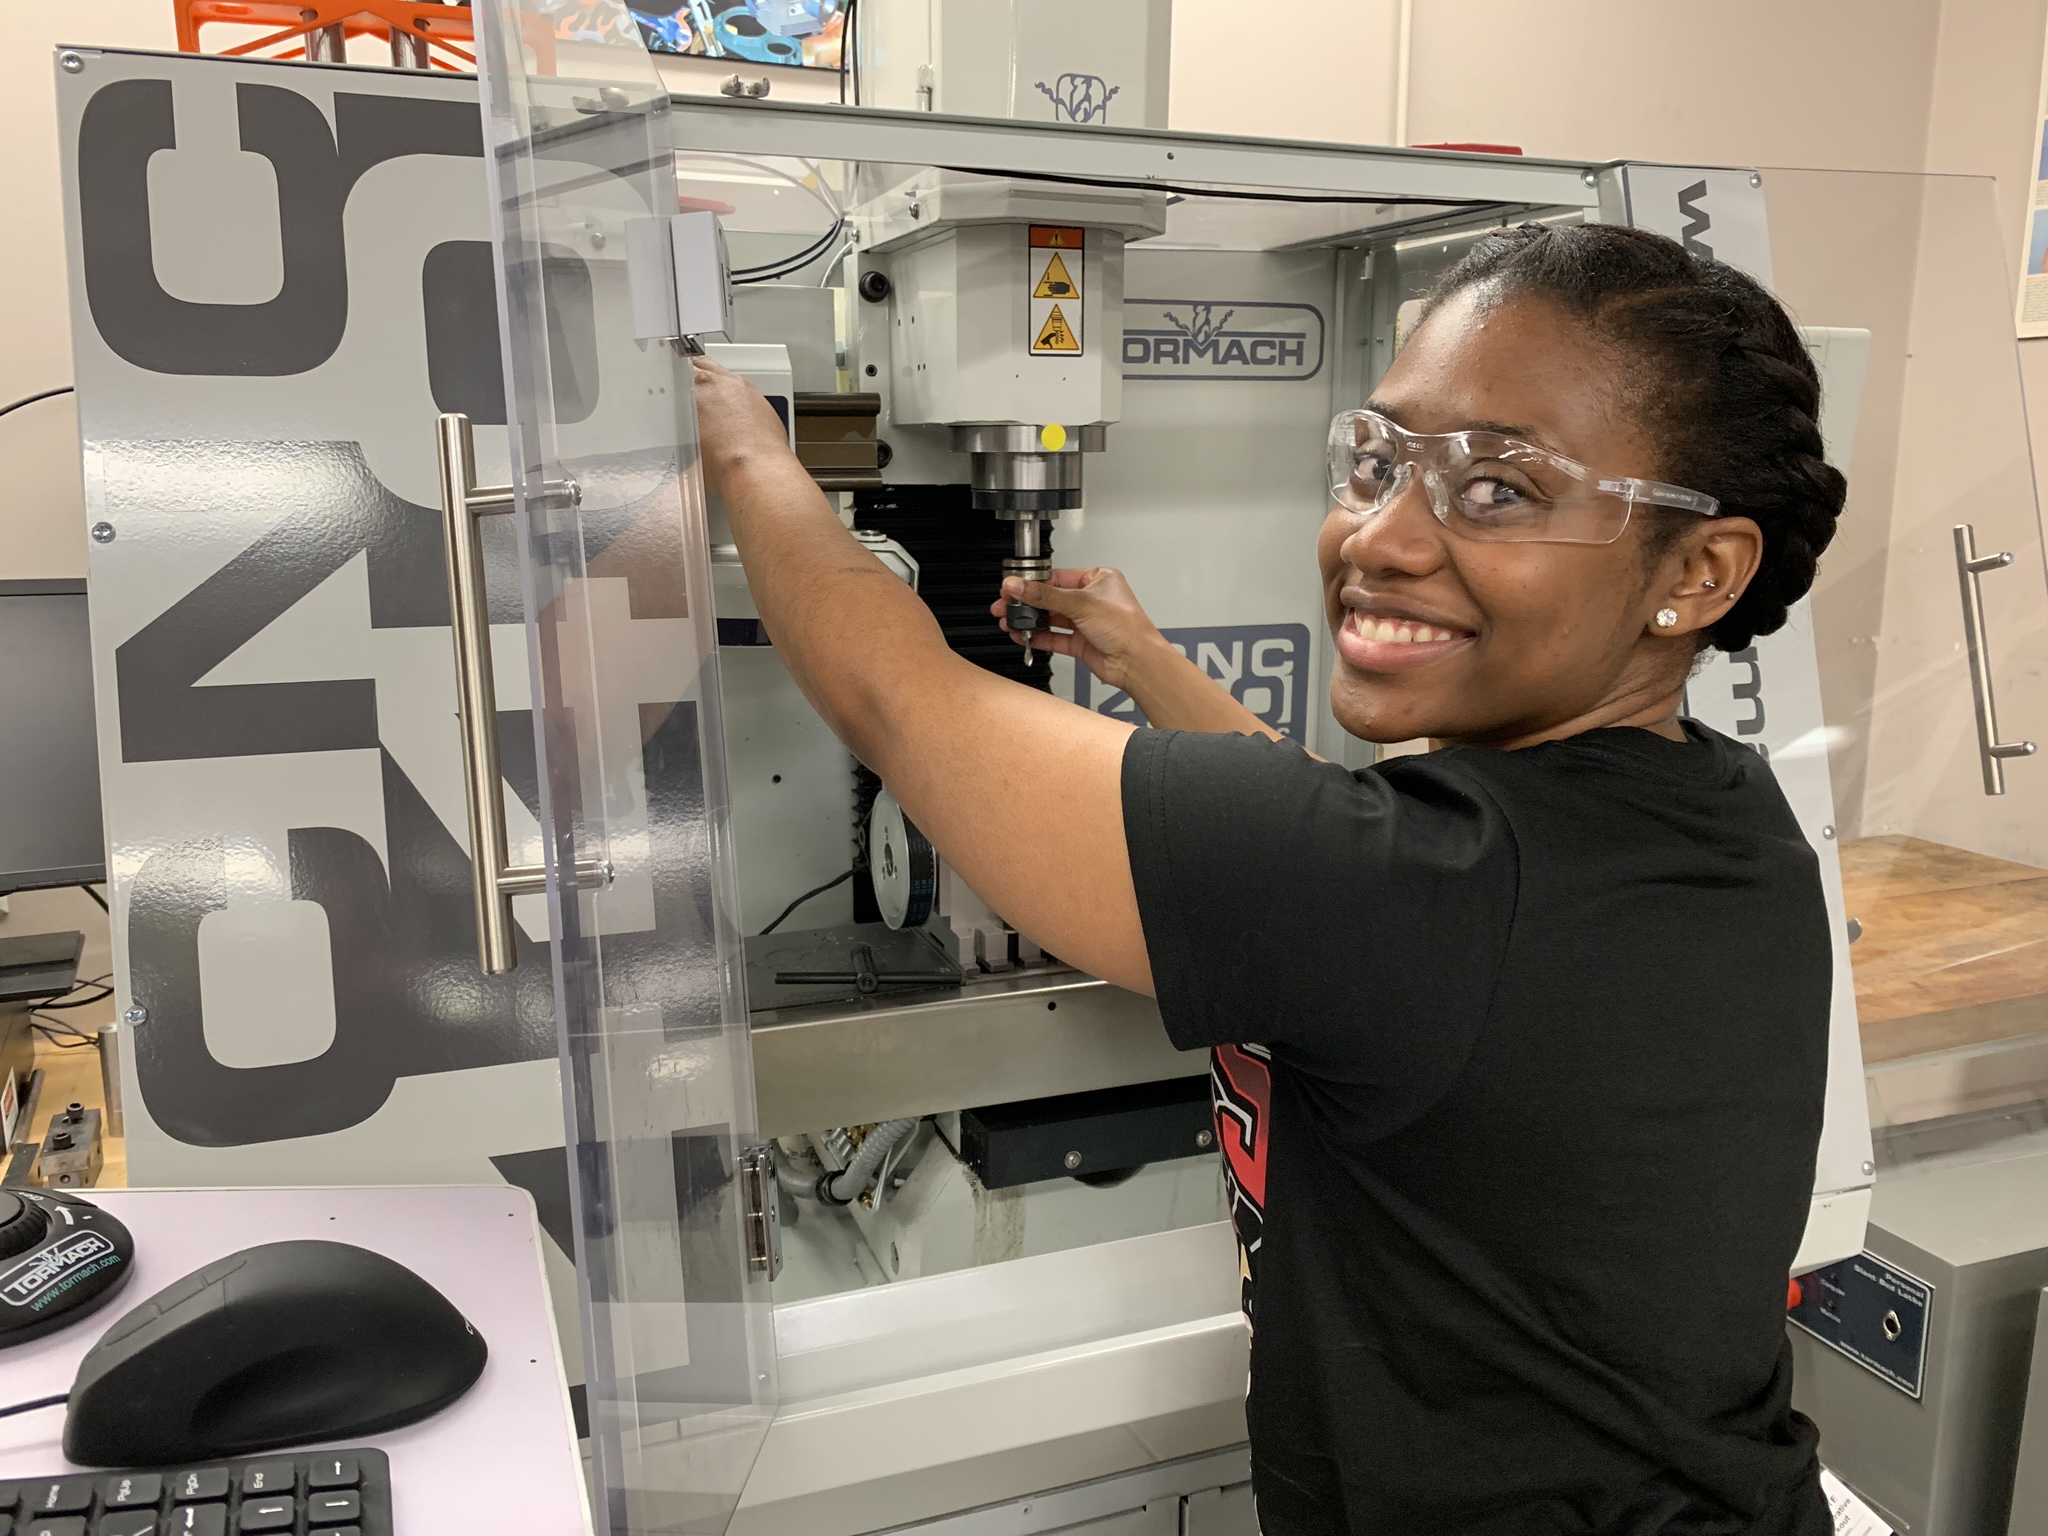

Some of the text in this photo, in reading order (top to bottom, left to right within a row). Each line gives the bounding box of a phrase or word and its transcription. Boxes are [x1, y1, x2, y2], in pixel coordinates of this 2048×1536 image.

[1122, 334, 1304, 366] ORMACH
[1171, 638, 1294, 680] NC
[3, 1237, 105, 1295] TORMACH
[30, 1255, 121, 1312] www.tormach.com
[1885, 1272, 1924, 1299] Personal
[117, 1479, 132, 1502] PgUp
[185, 1473, 199, 1495] PgDn
[253, 1472, 265, 1489] End
